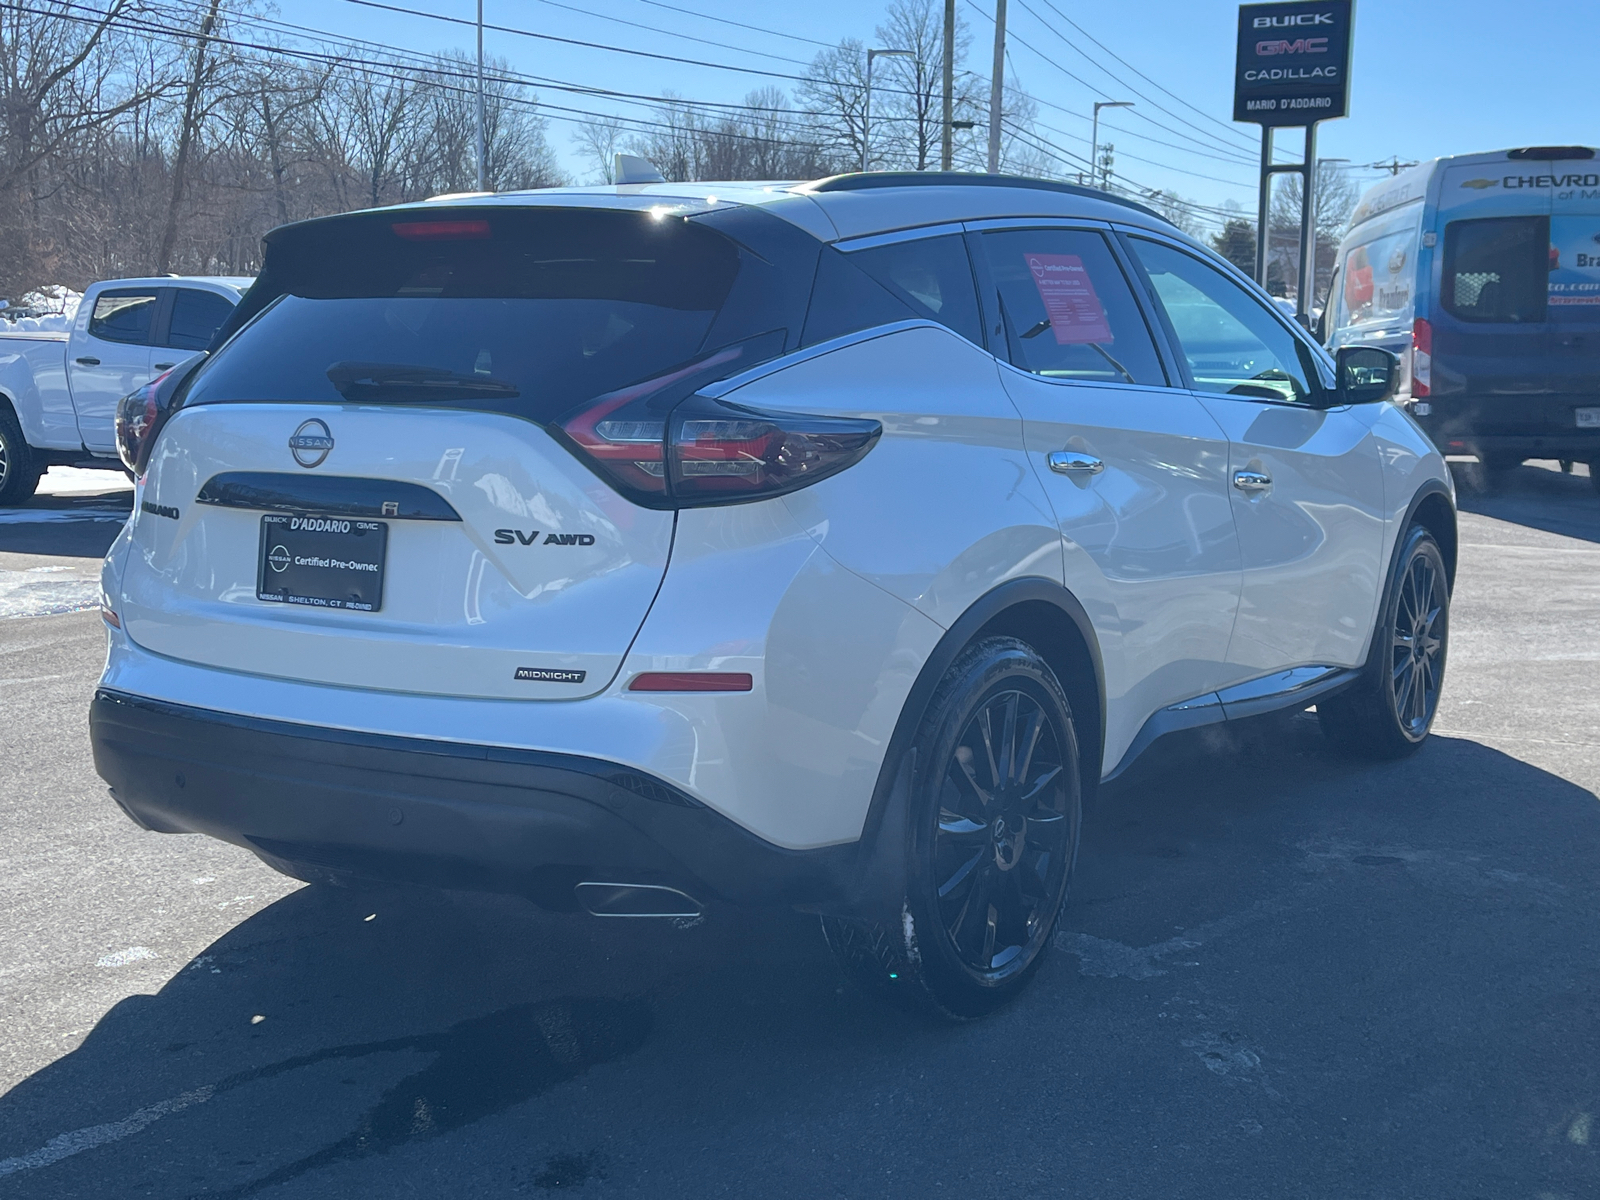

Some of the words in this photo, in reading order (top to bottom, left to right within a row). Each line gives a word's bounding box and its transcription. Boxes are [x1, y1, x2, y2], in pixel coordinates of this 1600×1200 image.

[1253, 13, 1334, 28] BUICK
[1256, 38, 1328, 55] GMC
[1244, 66, 1337, 81] CADILLAC
[1247, 99, 1276, 110] MARIO
[1281, 97, 1331, 109] D'ADDARIO
[1503, 174, 1599, 188] CHEVRO
[289, 438, 333, 448] NISSAN
[290, 517, 351, 533] D'ADDARIO
[356, 522, 379, 530] GMC
[494, 529, 540, 546] SV
[543, 533, 595, 546] AWD
[294, 556, 330, 568] Certified
[259, 593, 283, 602] NISSAN
[288, 595, 328, 606] SHELTON,
[518, 670, 581, 681] MIDNIGHT
